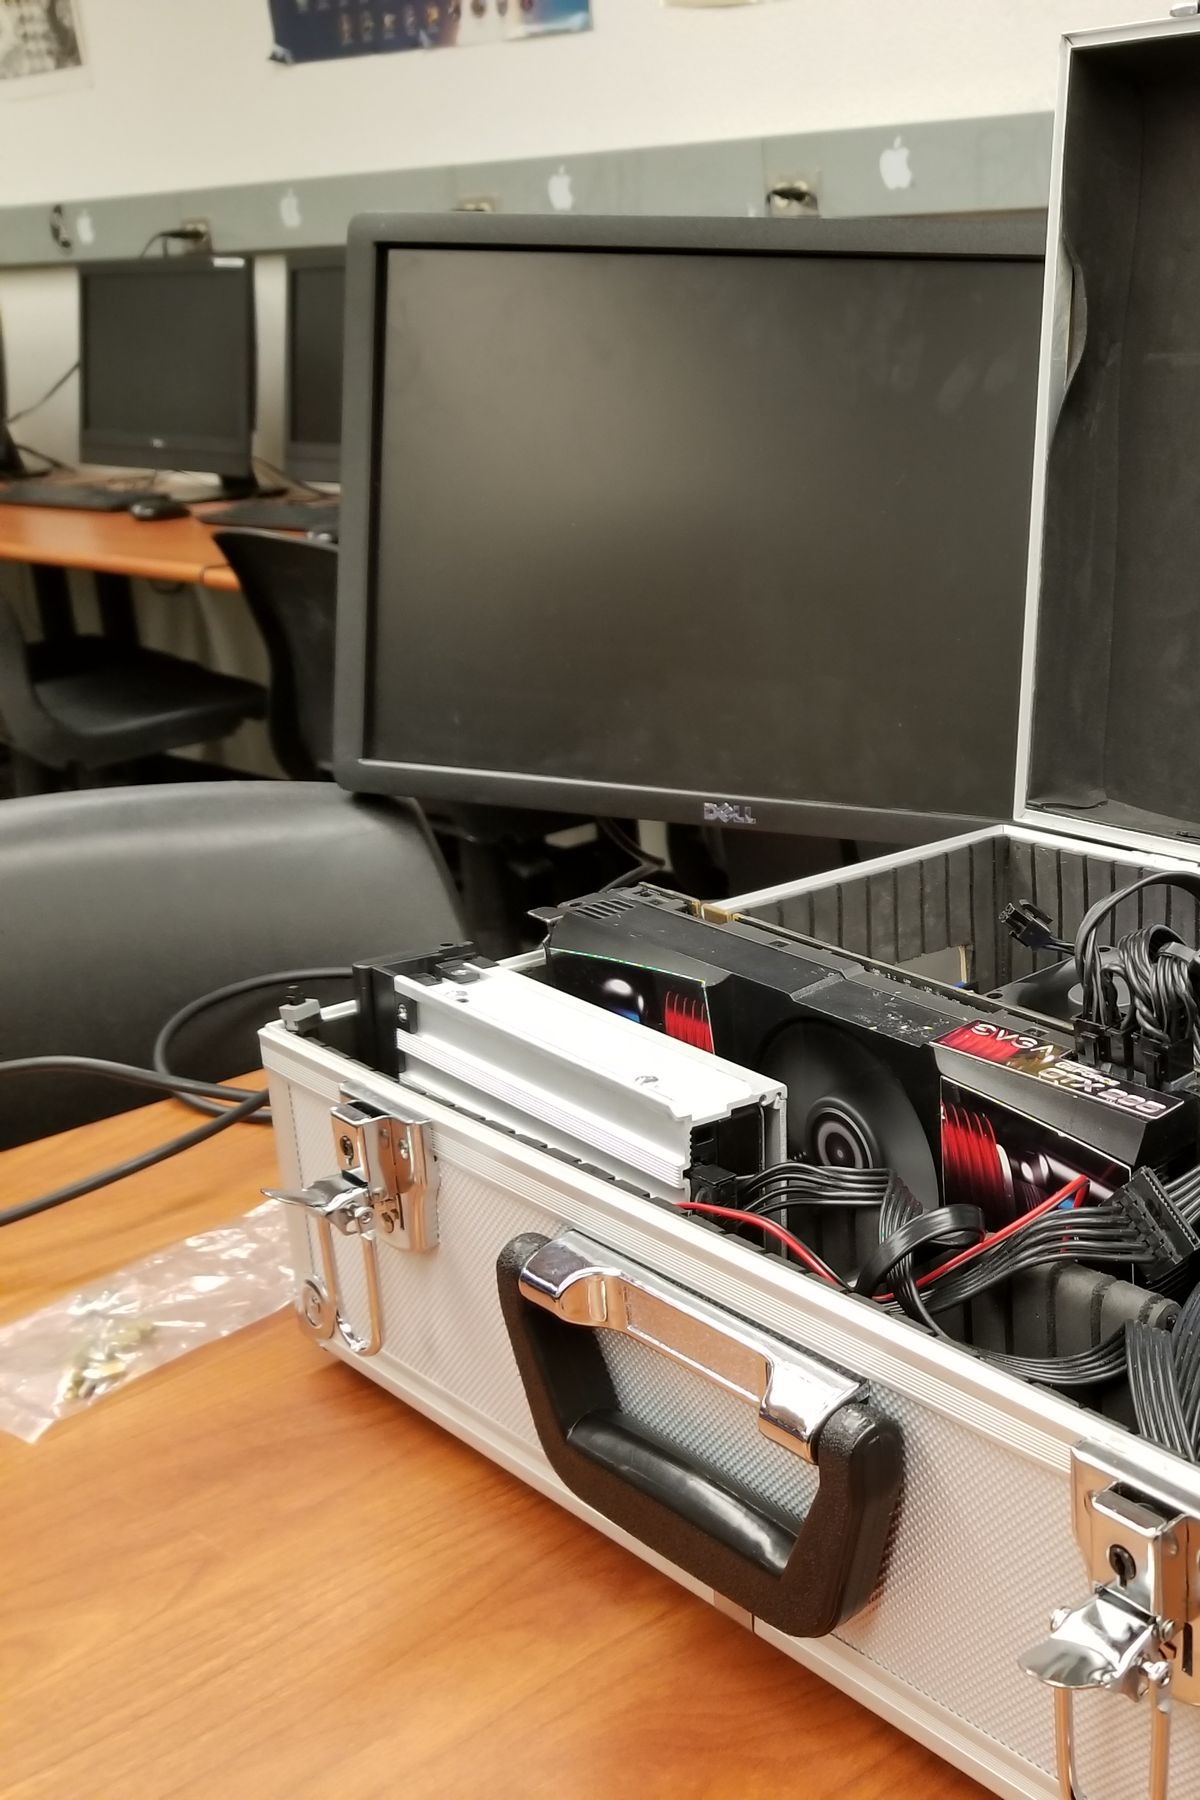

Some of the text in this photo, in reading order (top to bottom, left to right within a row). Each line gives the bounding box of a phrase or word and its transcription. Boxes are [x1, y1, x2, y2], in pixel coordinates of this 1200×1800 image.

[703, 802, 756, 824] DELL
[971, 1022, 1055, 1064] EVGA
[1039, 1067, 1106, 1092] GTX
